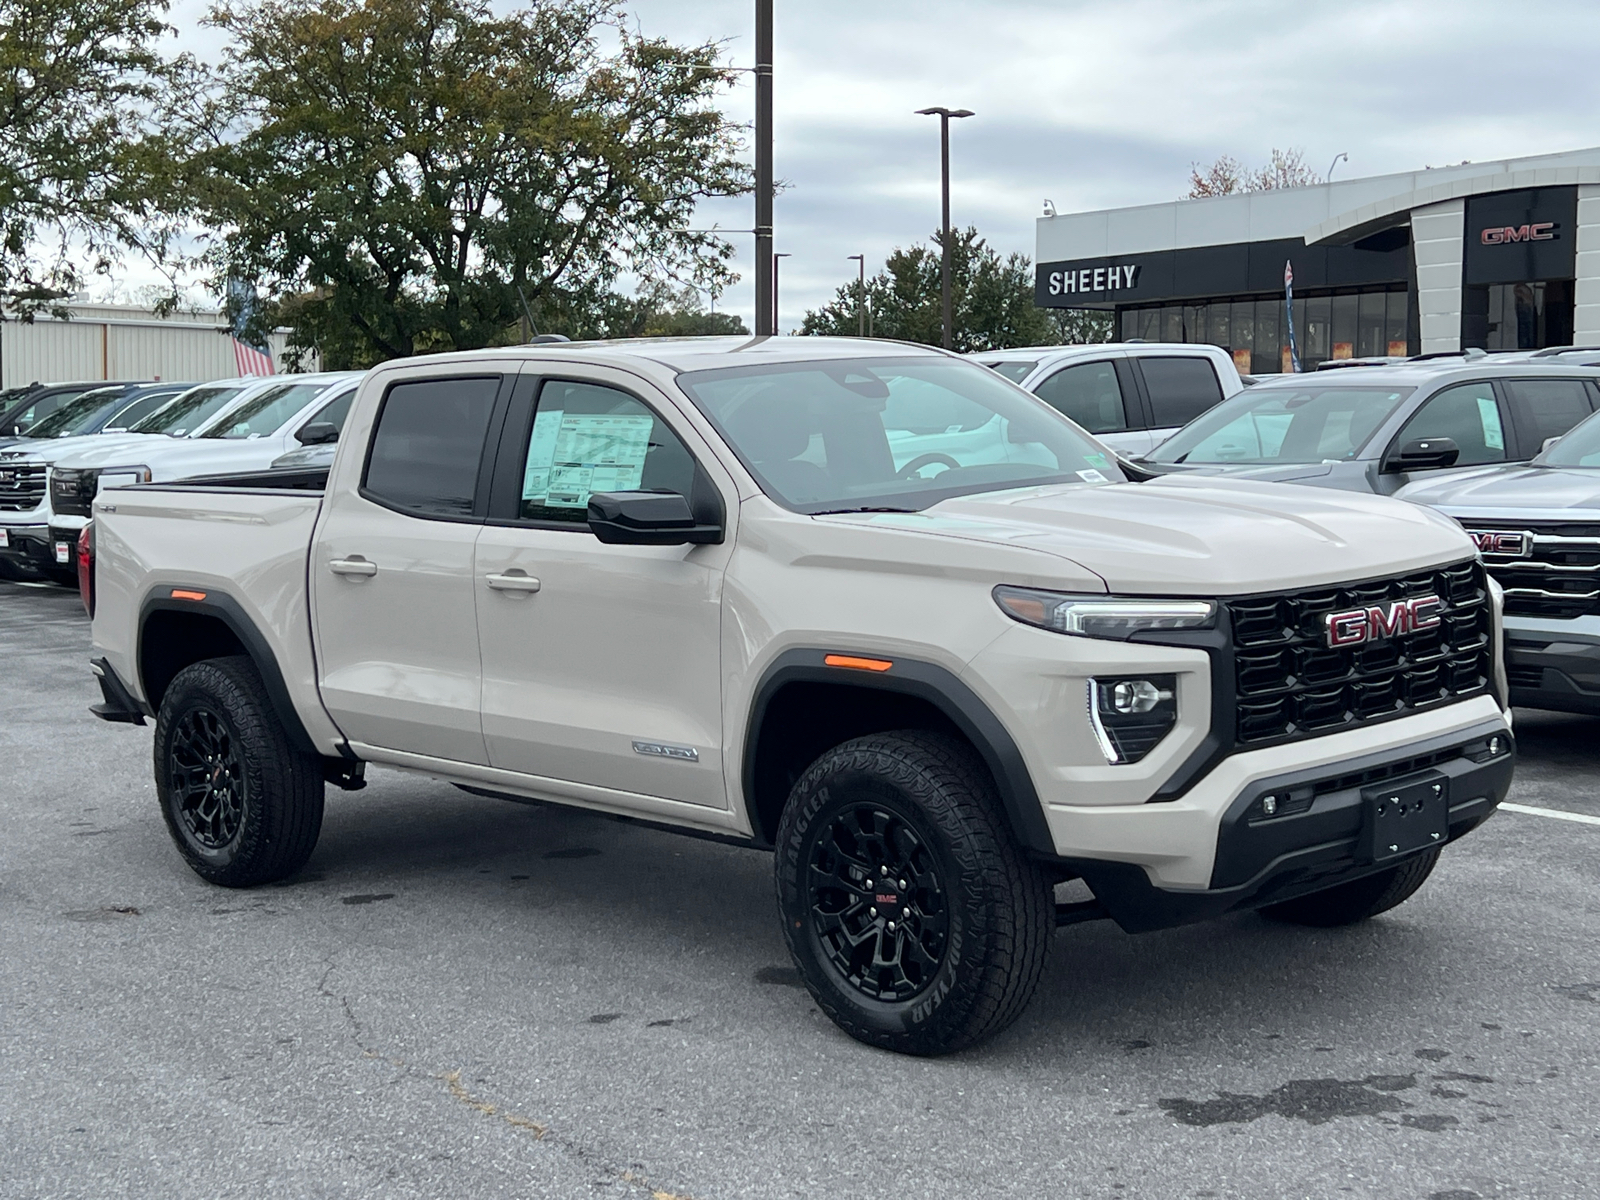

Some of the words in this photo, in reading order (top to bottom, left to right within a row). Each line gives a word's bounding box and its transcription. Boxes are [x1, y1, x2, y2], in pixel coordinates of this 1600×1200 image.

[1482, 222, 1554, 245] GMC
[1049, 265, 1135, 296] SHEEHY
[1470, 534, 1522, 553] MC
[1325, 595, 1441, 649] GMC
[876, 894, 898, 904] GMC
